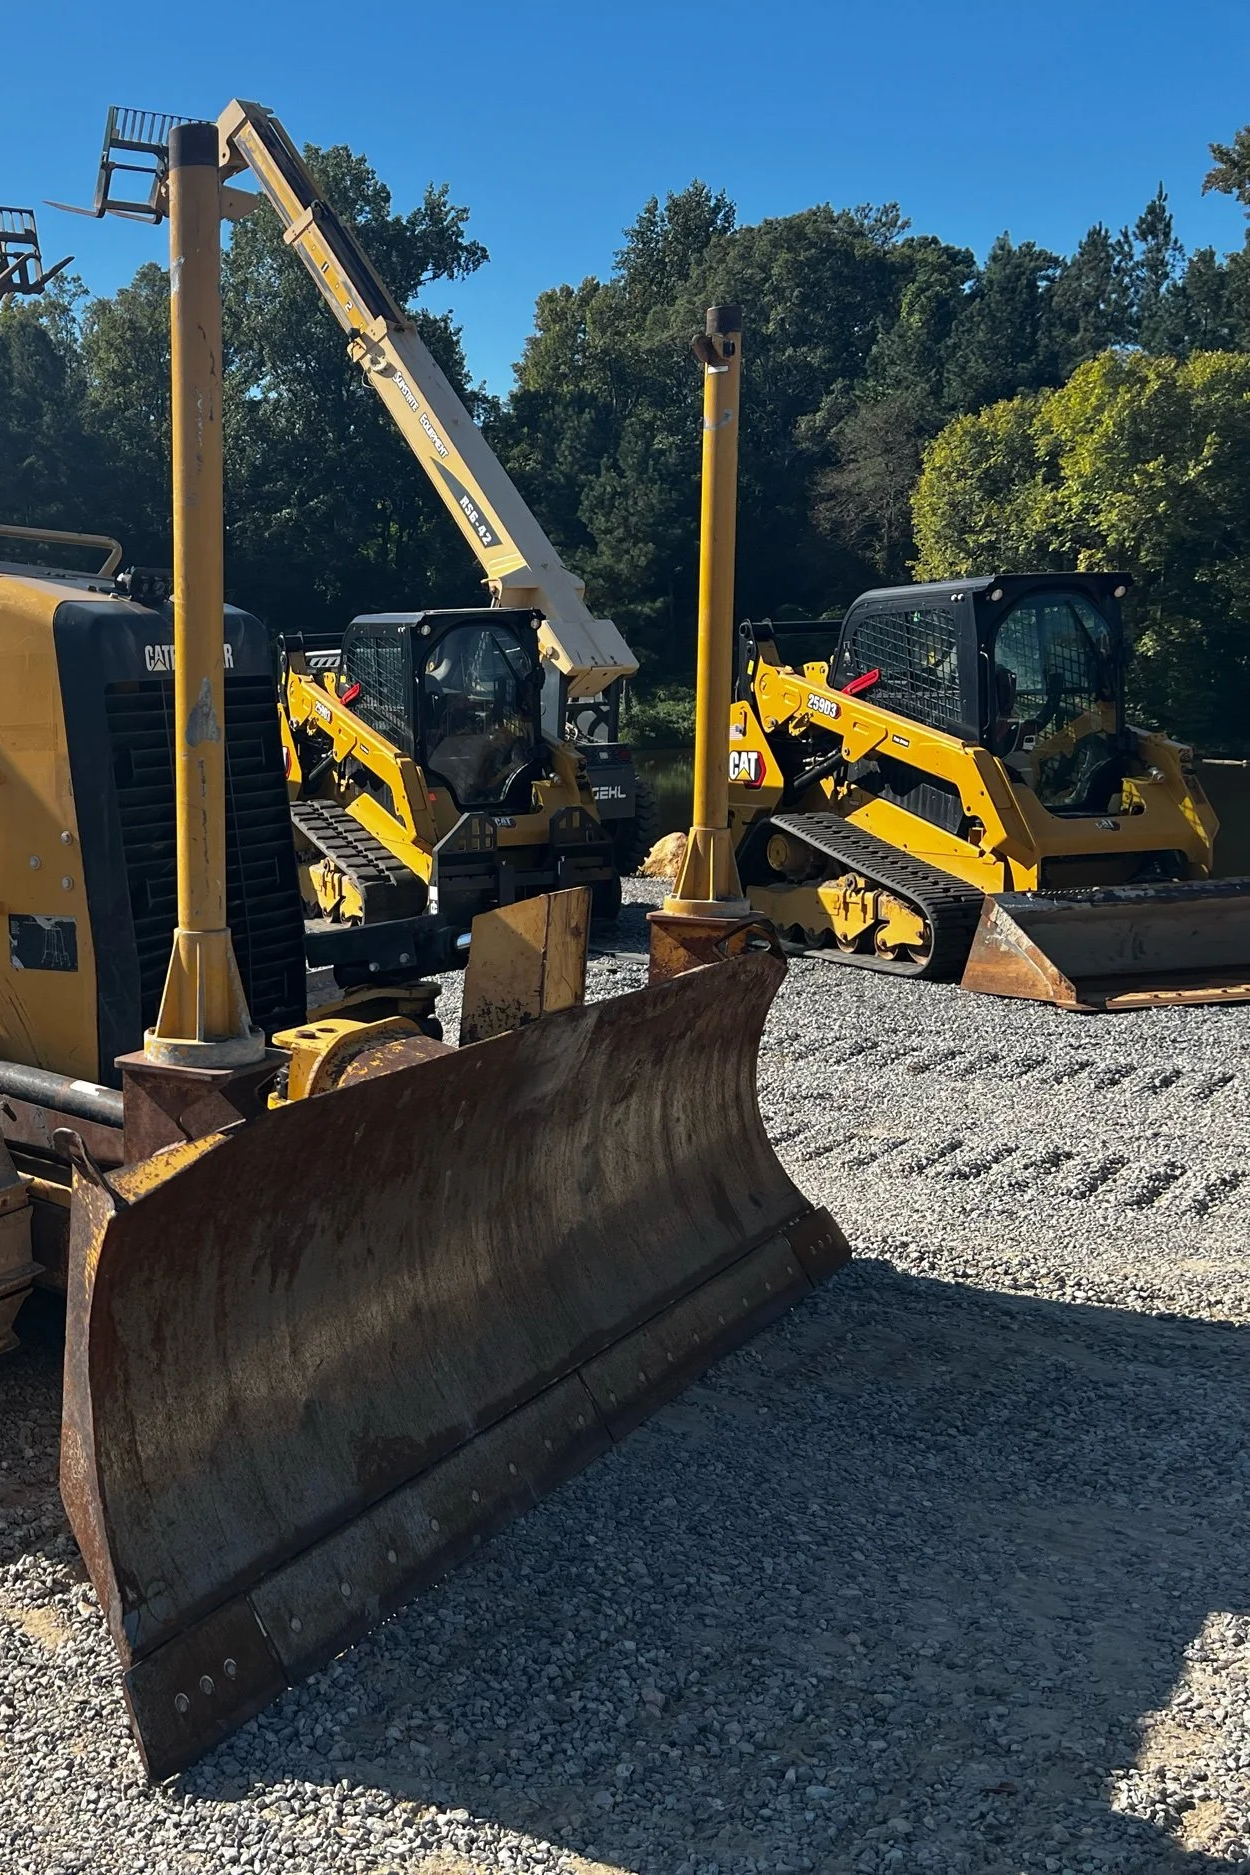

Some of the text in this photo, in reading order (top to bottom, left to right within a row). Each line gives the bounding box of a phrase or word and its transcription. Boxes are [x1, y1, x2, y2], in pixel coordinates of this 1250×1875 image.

[392, 370, 449, 458] SUNSTATE EQUIPMENT
[460, 495, 492, 546] RS6-42
[807, 694, 838, 717] 259D3
[729, 750, 758, 781] CAT
[493, 816, 511, 828] CAT
